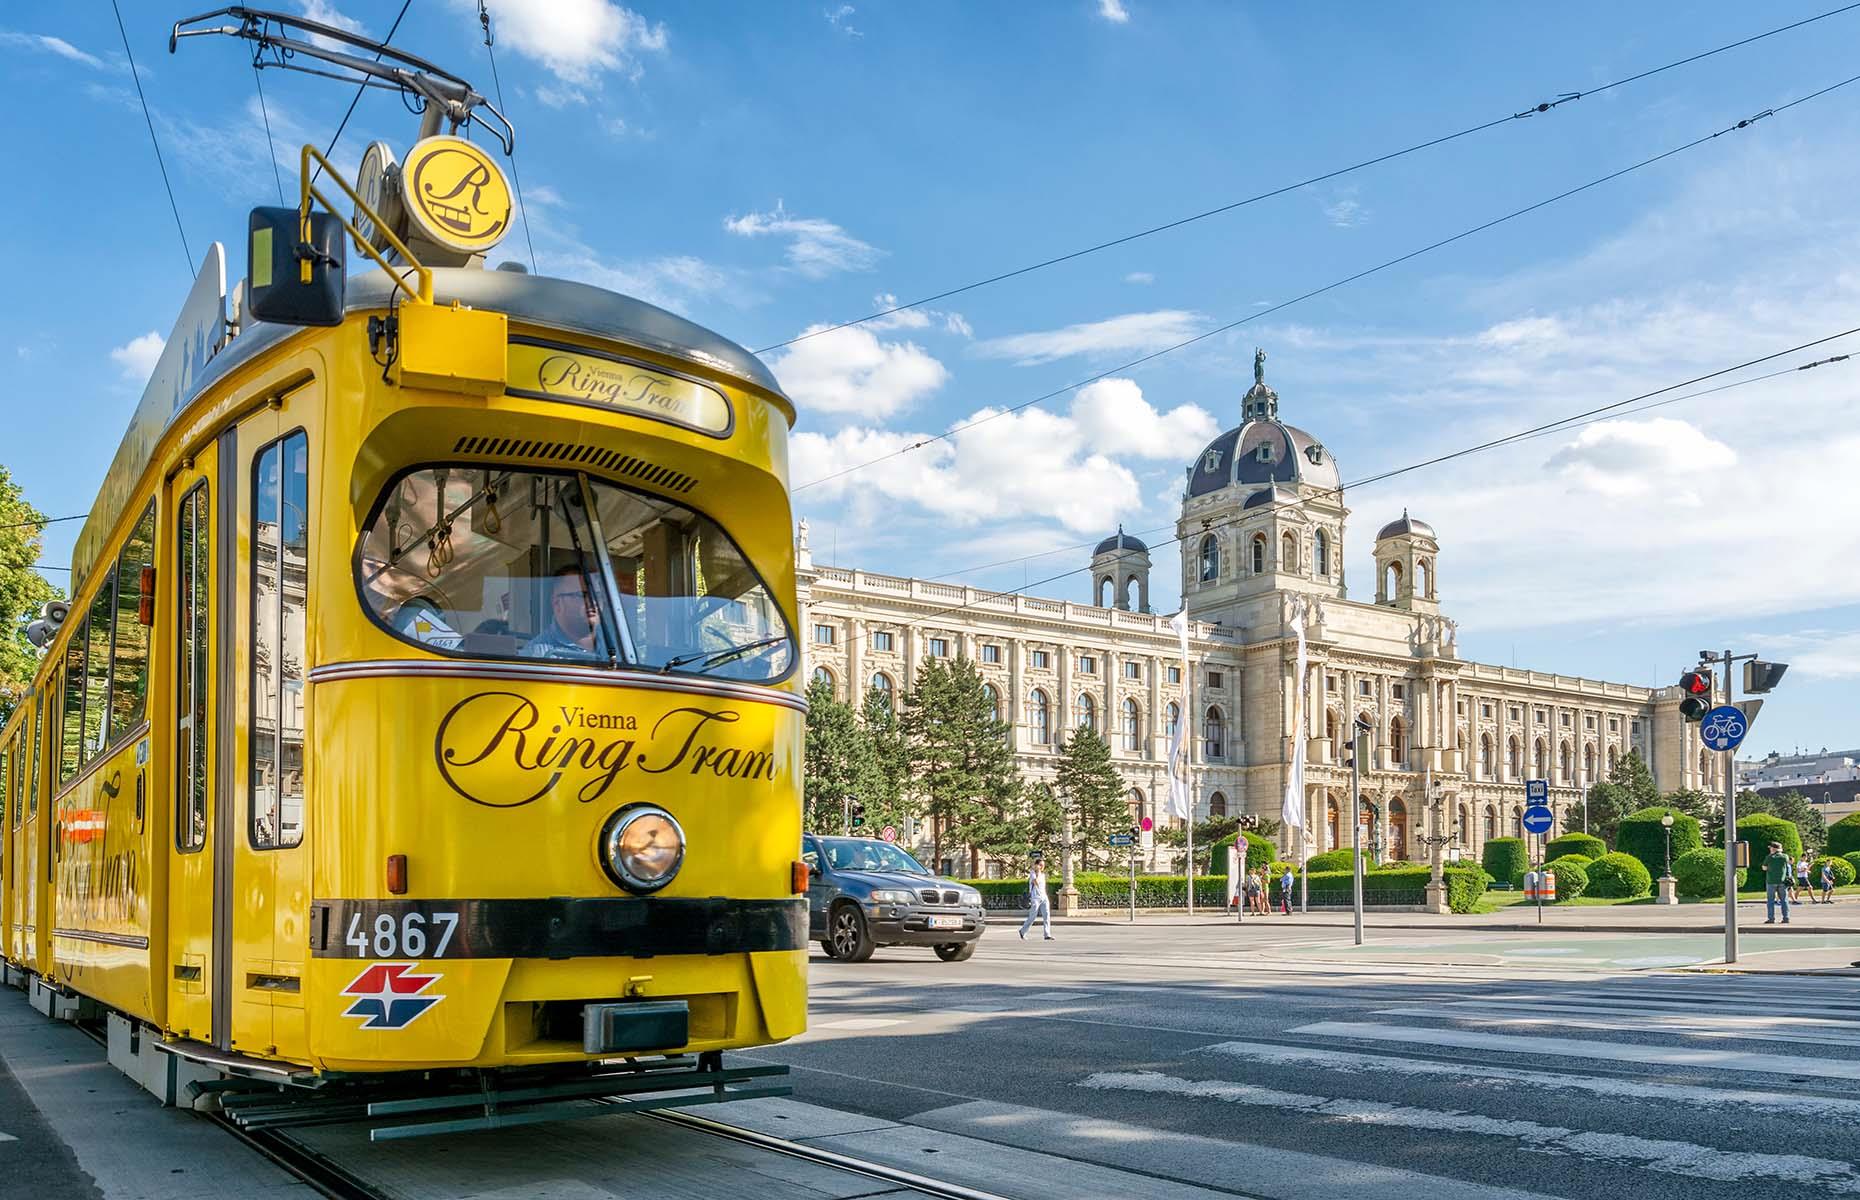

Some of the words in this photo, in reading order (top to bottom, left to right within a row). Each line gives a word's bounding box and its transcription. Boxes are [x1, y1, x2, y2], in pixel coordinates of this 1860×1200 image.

[538, 355, 621, 403] Ring
[588, 366, 624, 381] Vienna
[560, 706, 638, 730] Vienna
[434, 691, 635, 808] Ring
[637, 707, 779, 781] Tram
[1530, 785, 1544, 794] Taxi
[345, 912, 459, 958] 4867
